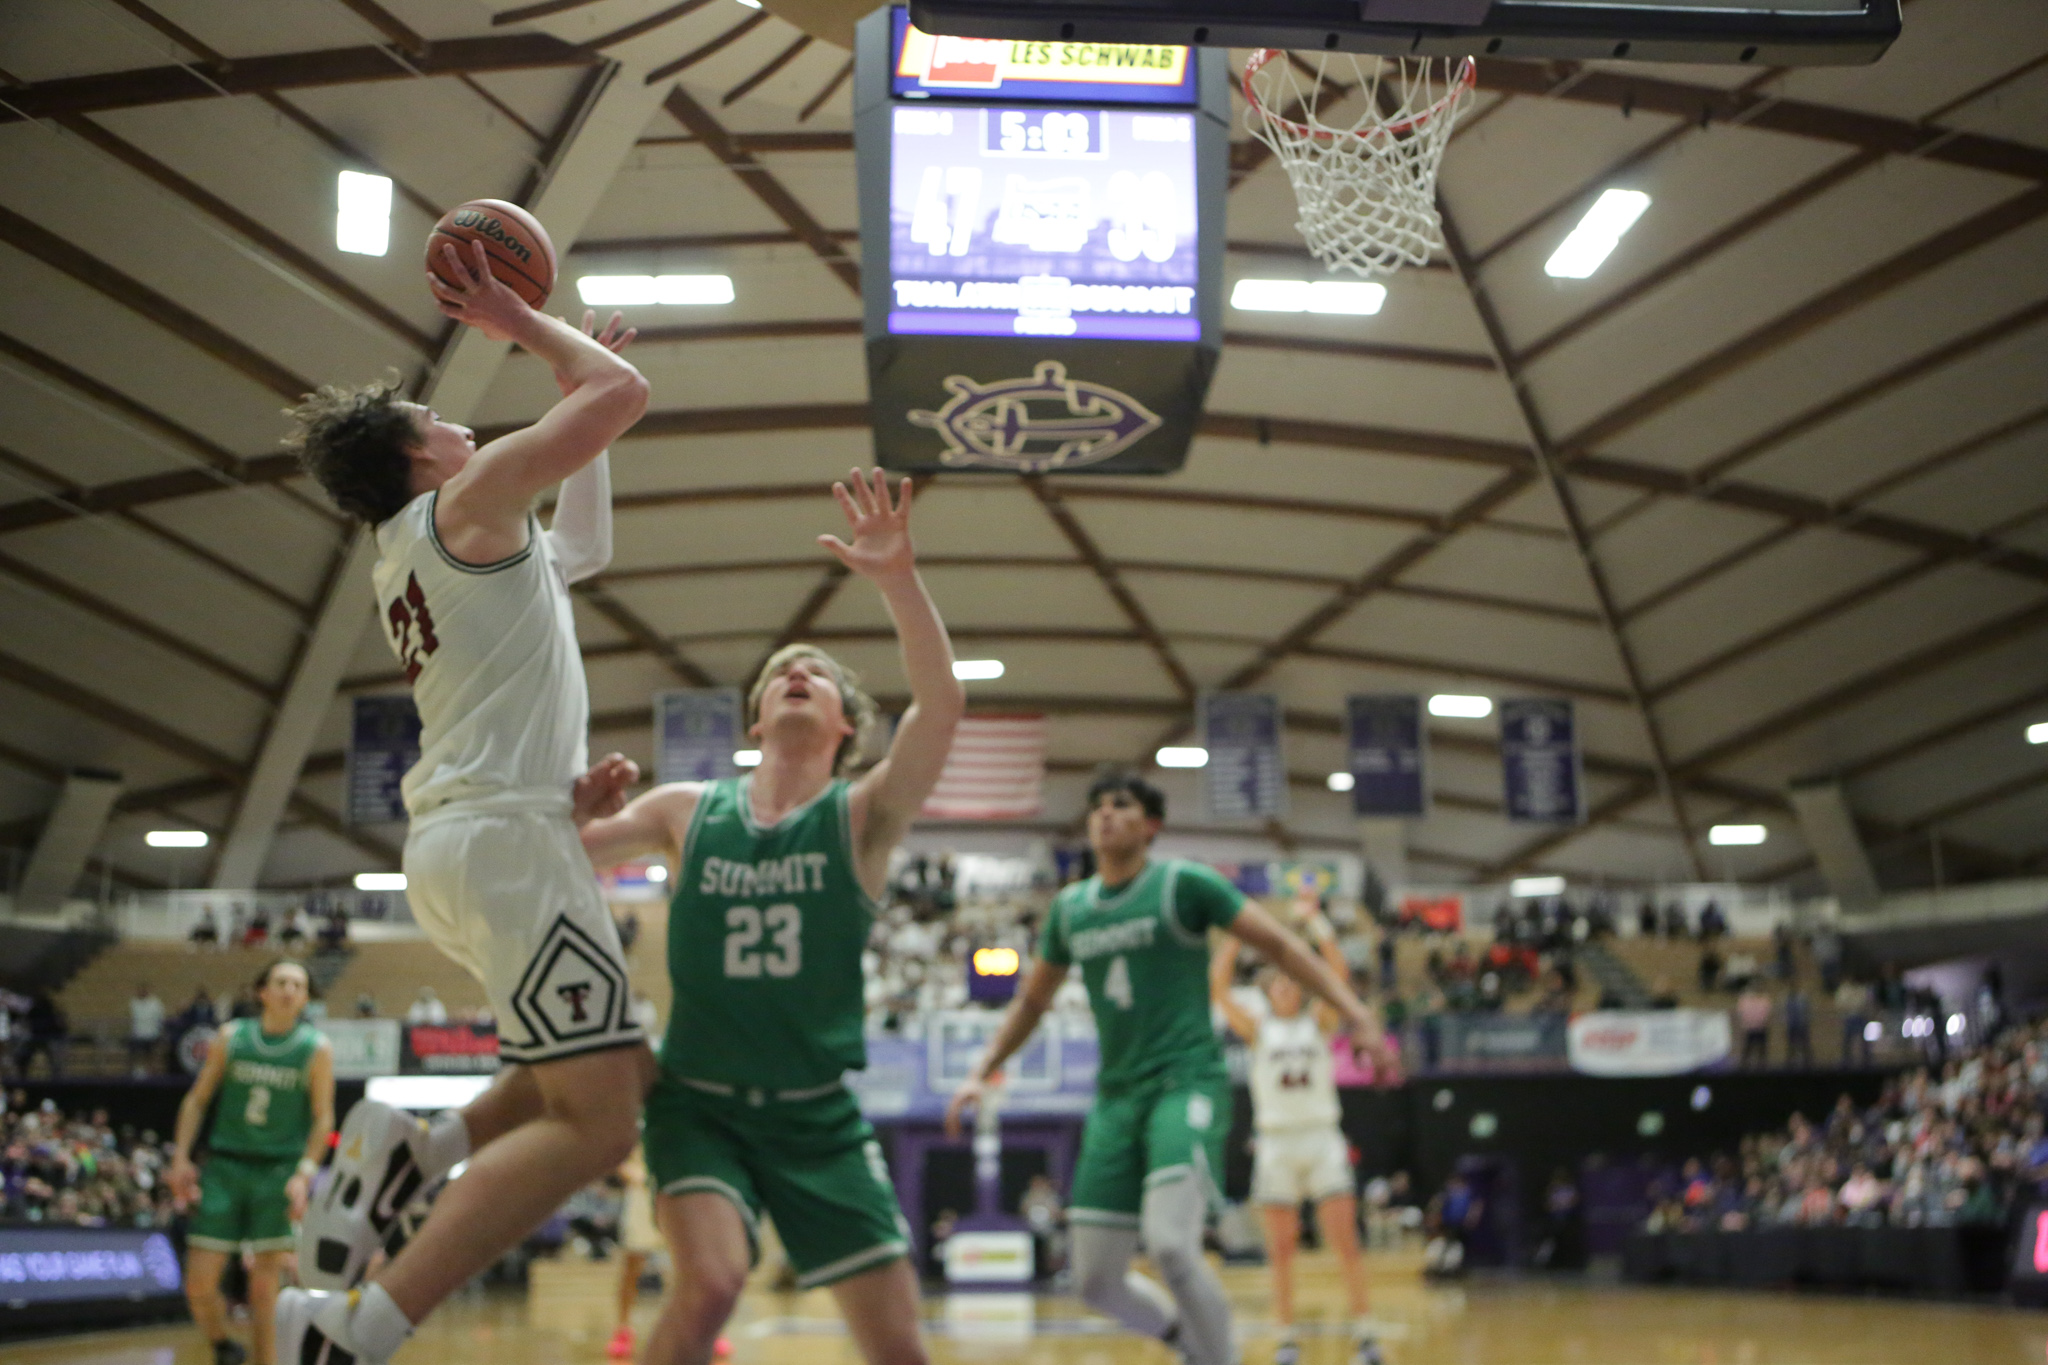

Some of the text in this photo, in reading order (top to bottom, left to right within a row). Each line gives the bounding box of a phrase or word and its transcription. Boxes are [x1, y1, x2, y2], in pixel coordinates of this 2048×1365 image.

[1010, 41, 1051, 66] LES
[1060, 43, 1174, 70] SCHWAB
[453, 209, 532, 264] Wilson
[912, 165, 983, 256] 47
[388, 569, 439, 686] 21
[699, 852, 828, 896] SUMMIT
[723, 903, 802, 978] 23
[557, 981, 590, 1022] T
[1103, 956, 1133, 1010] 4
[246, 1085, 270, 1125] 2
